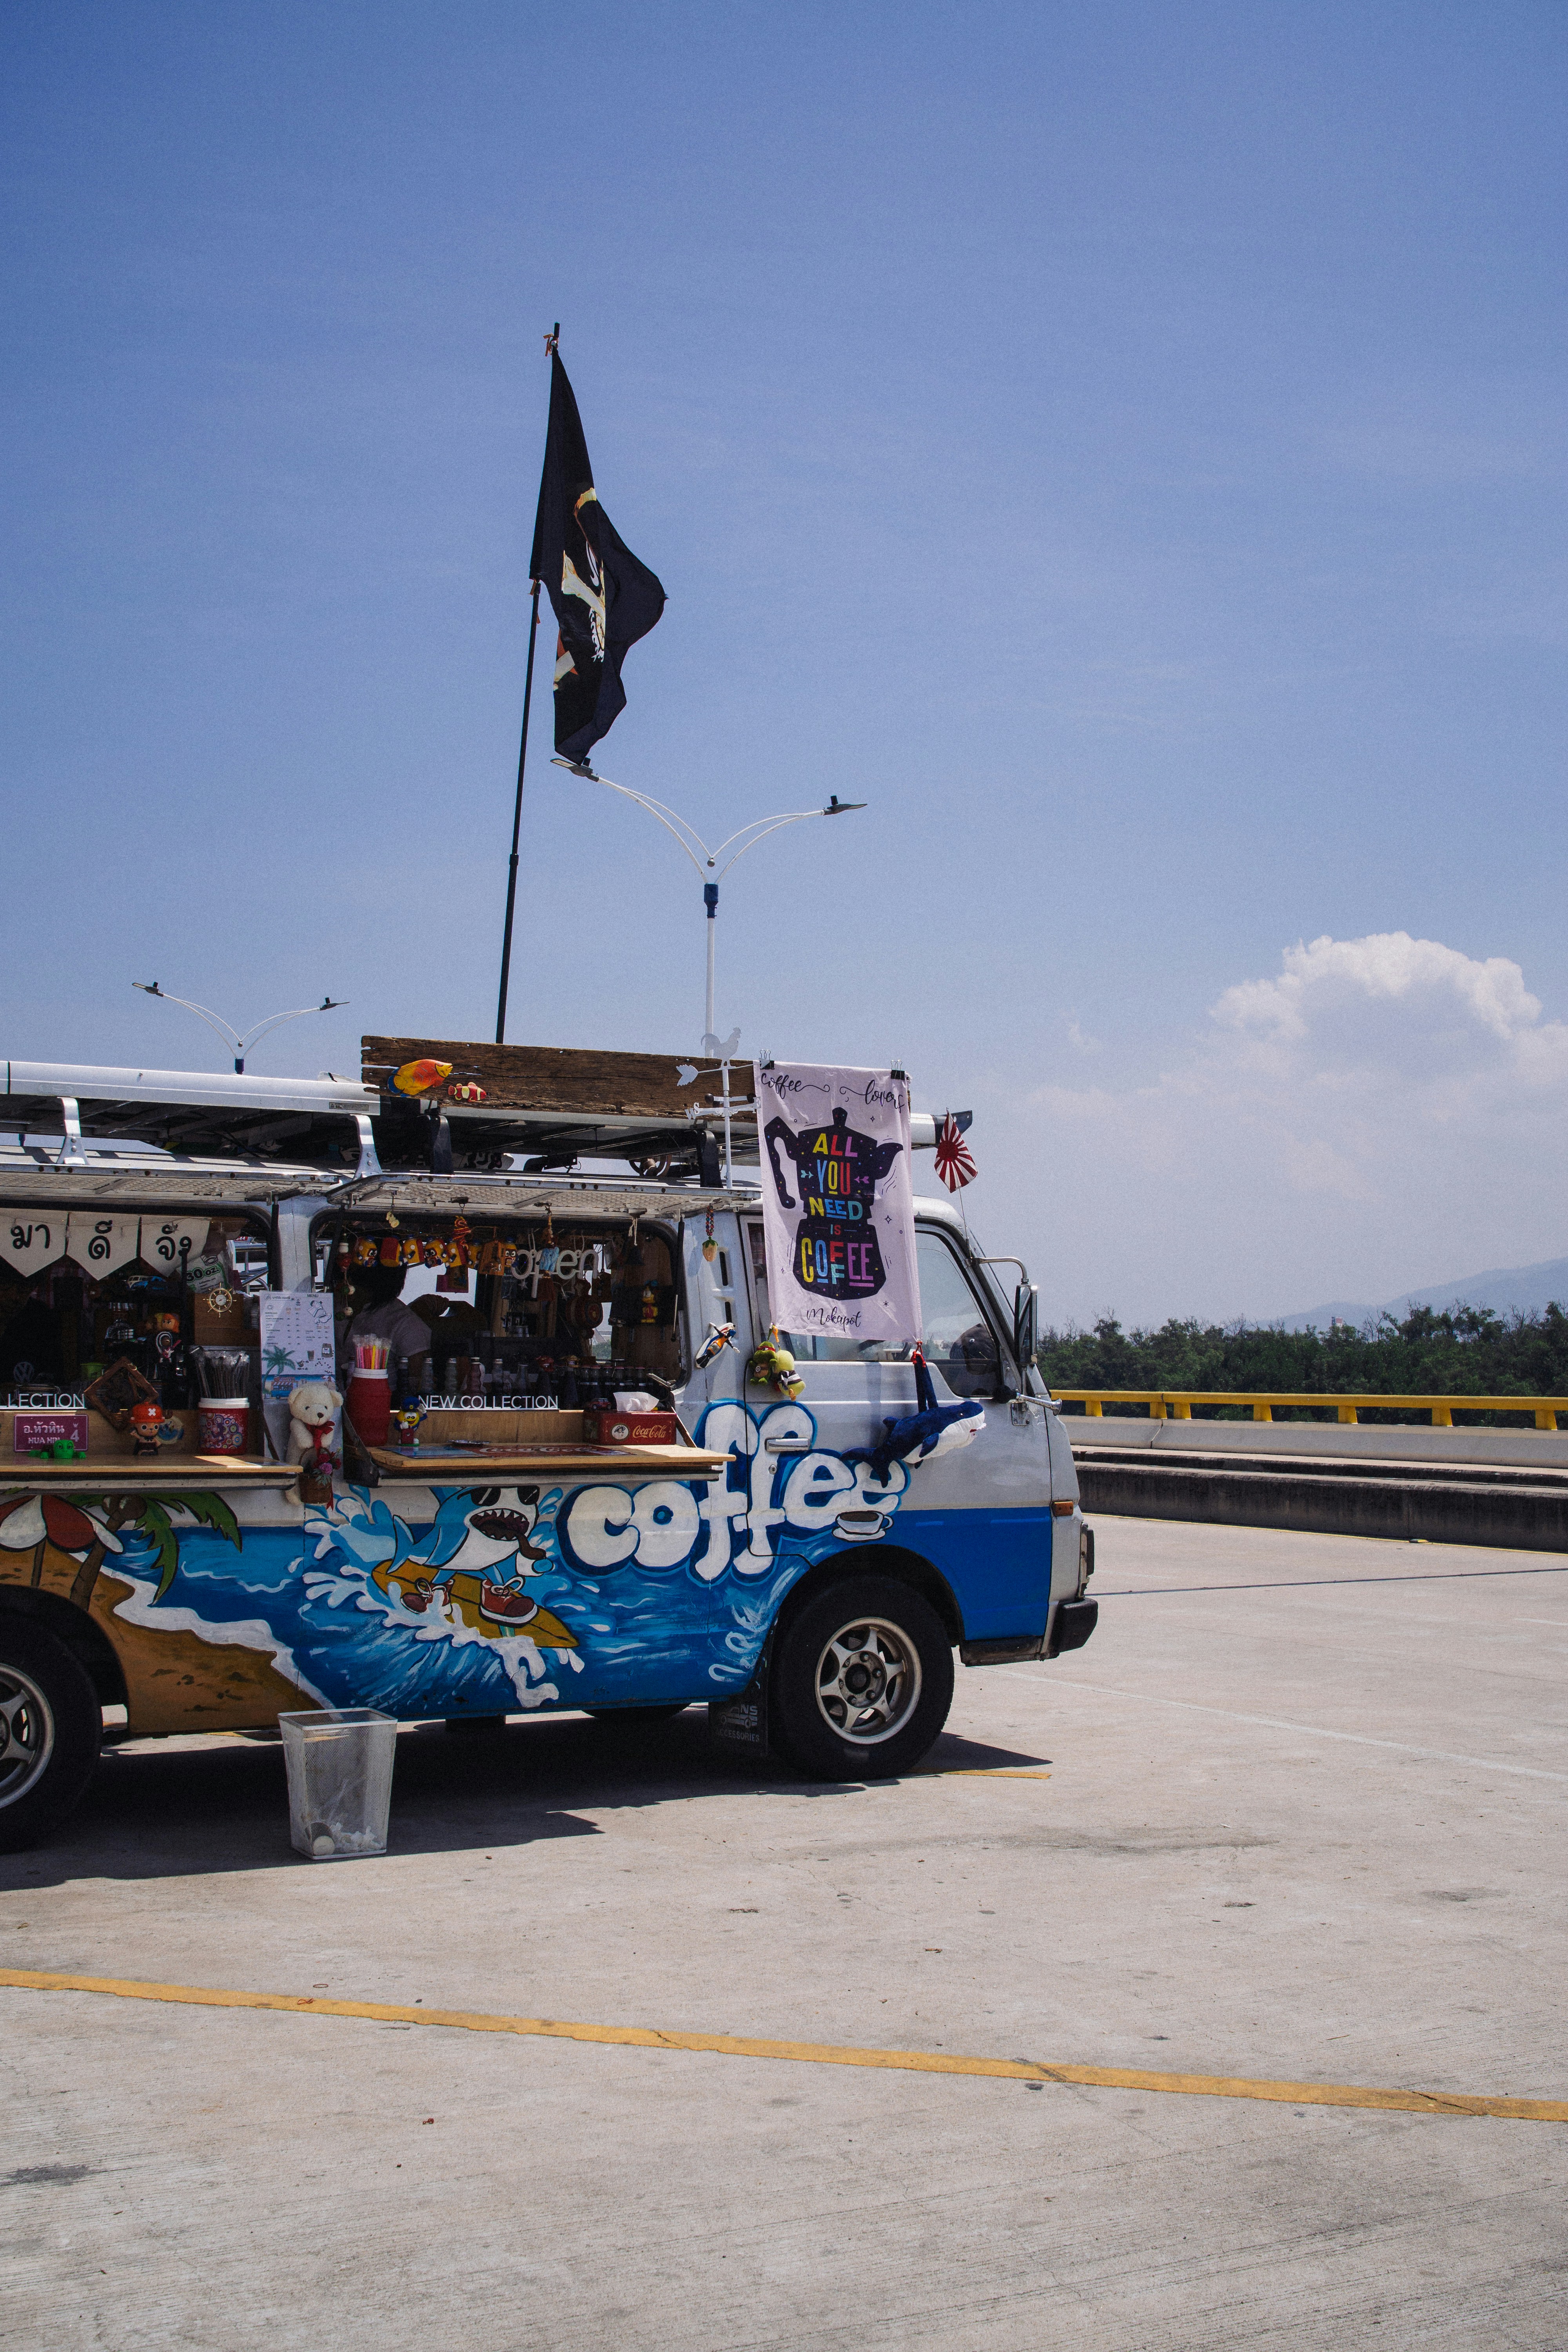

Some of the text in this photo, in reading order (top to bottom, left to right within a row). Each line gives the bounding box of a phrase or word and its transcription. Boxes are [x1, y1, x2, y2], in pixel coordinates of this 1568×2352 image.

[761, 1073, 905, 1113] coffee lovers
[812, 1133, 858, 1158] ALL
[817, 1159, 851, 1195] YOU
[809, 1197, 863, 1220] NEED
[830, 1224, 841, 1235] IS
[801, 1238, 874, 1285] COFFEE
[187, 1267, 220, 1281] 30 oz.
[511, 1249, 599, 1298] open
[806, 1306, 862, 1333] Mokapot
[0, 1393, 85, 1408] LECTION
[418, 1395, 558, 1408] NEW COLLECTION
[23, 1421, 65, 1434] อ.หัวหิน
[70, 1429, 79, 1442] 4
[566, 1402, 906, 1581] coffee
[741, 1704, 758, 1715] NS
[717, 1728, 760, 1742] CCESSORIES
